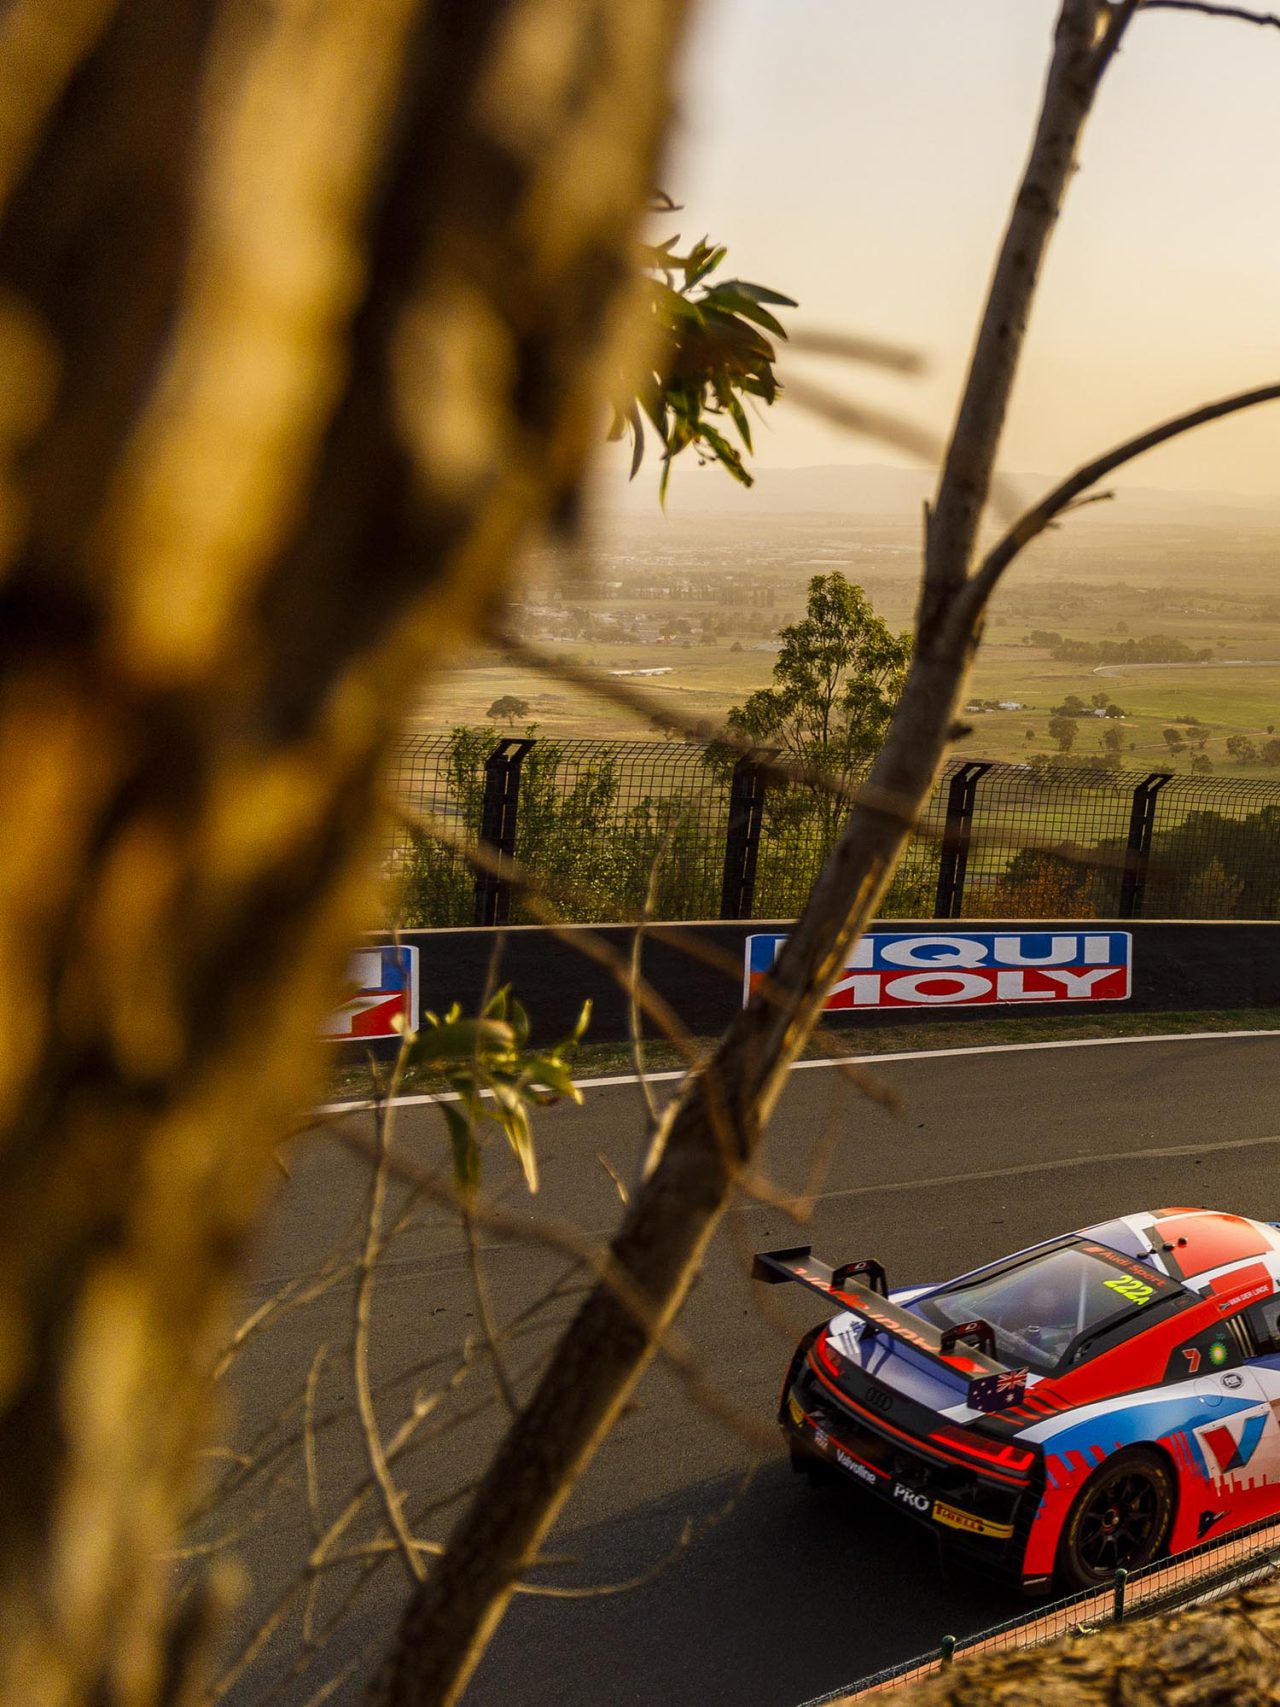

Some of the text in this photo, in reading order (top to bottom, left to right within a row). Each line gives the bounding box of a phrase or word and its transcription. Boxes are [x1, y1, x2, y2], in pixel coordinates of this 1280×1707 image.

[775, 936, 1109, 968] IQUI
[1130, 1264, 1167, 1288] Sport
[836, 1449, 876, 1484] Valvoline
[893, 1483, 930, 1511] PRO
